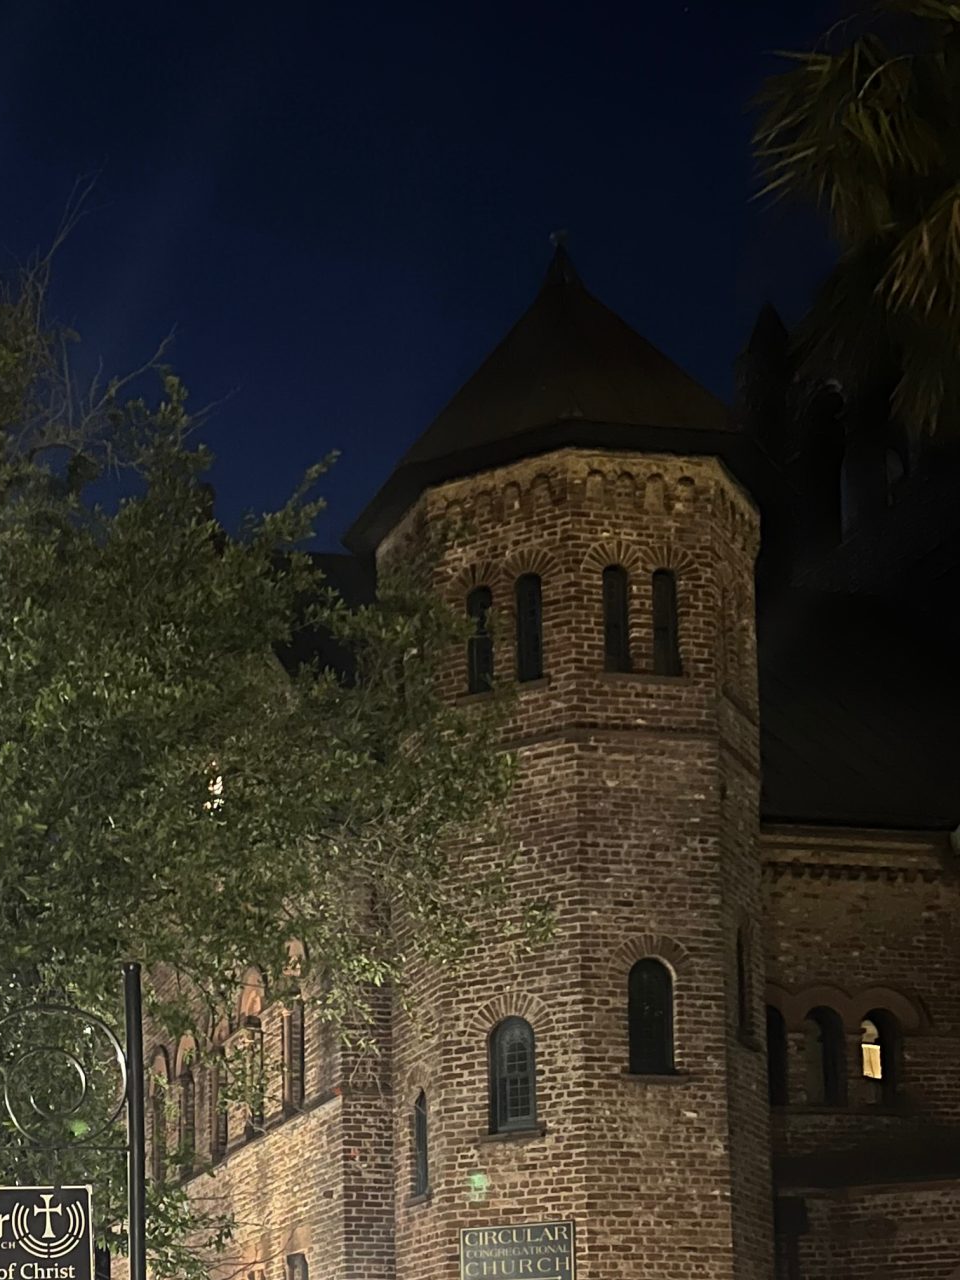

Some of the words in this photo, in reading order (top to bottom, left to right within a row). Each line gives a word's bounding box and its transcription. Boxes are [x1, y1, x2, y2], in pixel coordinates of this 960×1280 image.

[465, 1226, 568, 1246] CIRCULAR
[466, 1245, 569, 1258] CONGREGATIONAL
[20, 1263, 75, 1279] Christ
[466, 1257, 569, 1277] CHURCH
